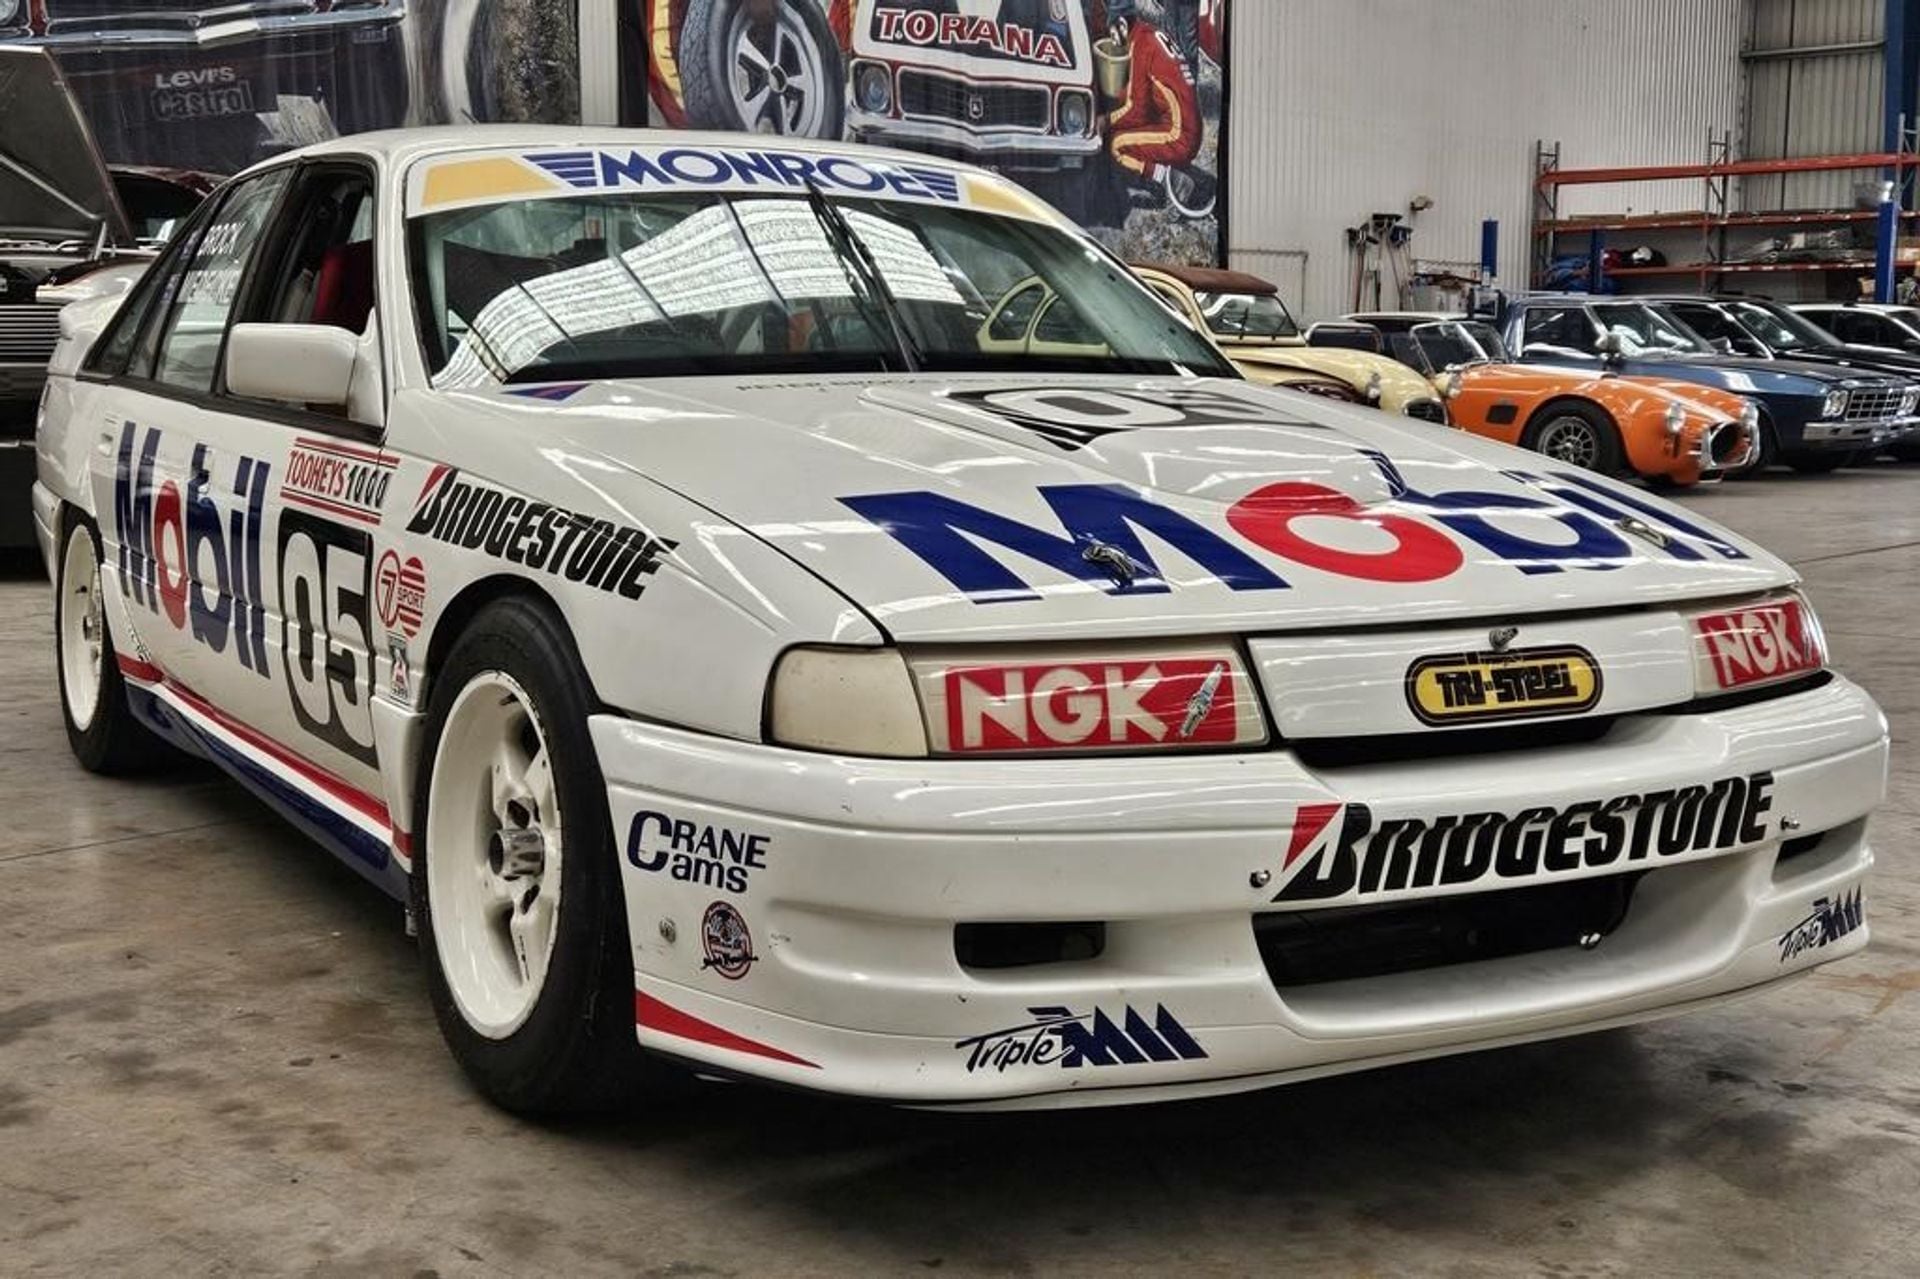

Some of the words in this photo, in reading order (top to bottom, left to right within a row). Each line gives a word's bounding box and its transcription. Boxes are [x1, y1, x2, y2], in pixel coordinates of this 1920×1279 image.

[875, 8, 1072, 68] TORANA
[152, 80, 252, 121] Castrol
[598, 149, 929, 198] MONROE
[285, 449, 348, 497] TOOHEYS
[345, 464, 392, 508] 1000
[115, 420, 272, 681] Mobil
[406, 466, 681, 601] BRIDGESTONE
[836, 449, 1751, 605] Mobil
[398, 586, 424, 610] SPORT
[283, 531, 375, 750] 05
[1706, 605, 1801, 685] NGK
[959, 660, 1169, 749] NGK
[1435, 662, 1579, 708] TRI-STEEL
[627, 810, 771, 872] CRANE
[1271, 769, 1775, 903] BRIDGESTONE
[955, 1018, 1080, 1073] Triple
